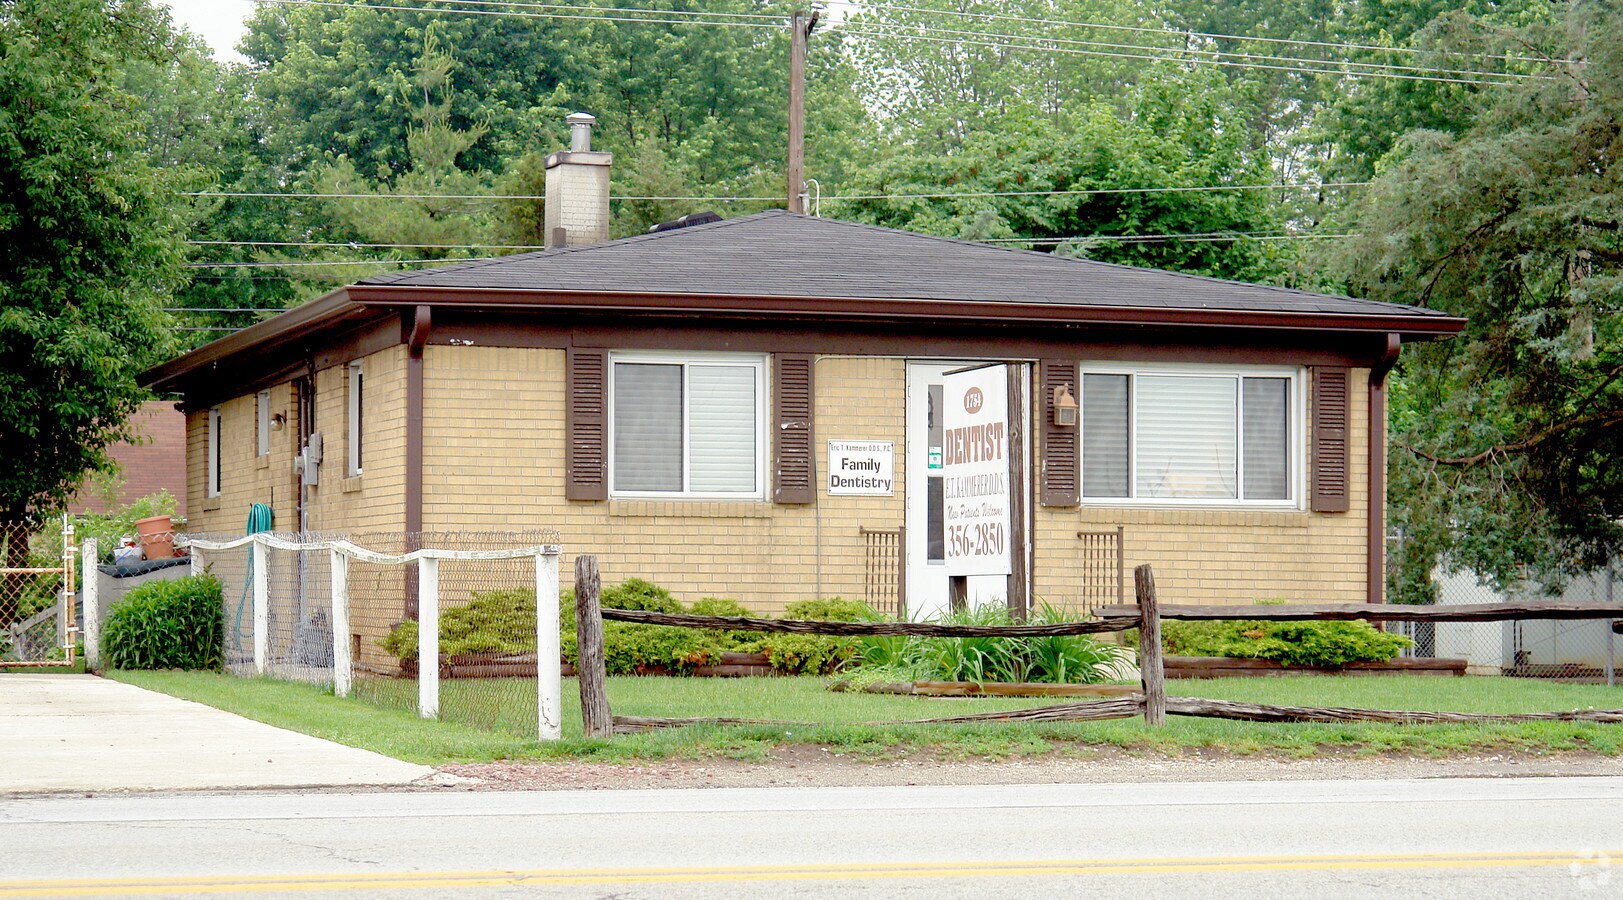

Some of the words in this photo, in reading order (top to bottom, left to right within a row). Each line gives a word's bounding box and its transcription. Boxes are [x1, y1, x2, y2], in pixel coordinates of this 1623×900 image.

[945, 421, 1004, 466] DENTIST
[841, 457, 881, 474] Family
[831, 474, 891, 491] Dentistry
[956, 473, 988, 499] KAMMERER
[947, 504, 959, 520] New
[960, 503, 980, 520] Patients
[981, 502, 1003, 518] Welcome
[948, 522, 1004, 557] 356-2850
